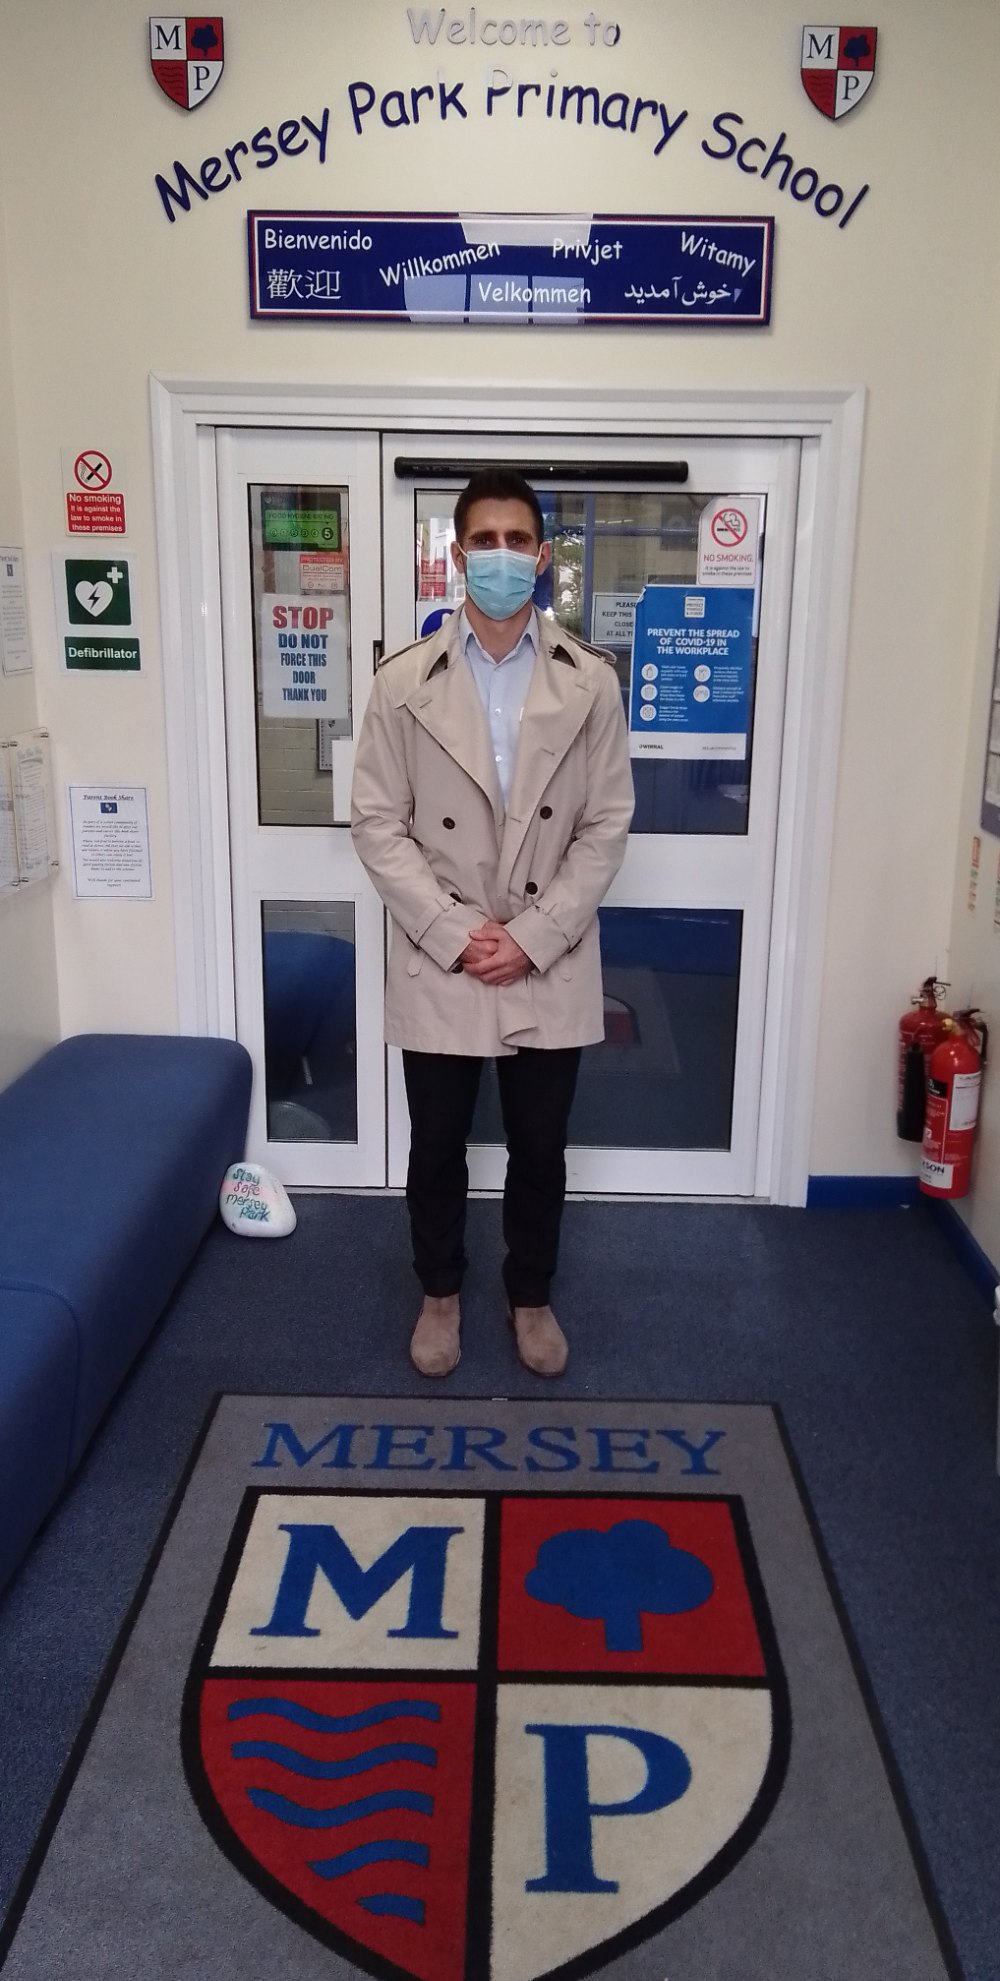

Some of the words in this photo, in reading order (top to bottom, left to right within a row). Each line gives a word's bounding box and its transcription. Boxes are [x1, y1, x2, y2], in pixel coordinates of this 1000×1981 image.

[155, 25, 183, 50] M
[406, 7, 571, 47] Welcome
[584, 12, 621, 48] to
[806, 33, 835, 59] M
[193, 66, 210, 91] P
[842, 75, 859, 100] P
[155, 107, 330, 223] Mersey
[348, 66, 467, 135] Park
[486, 67, 688, 156] Primary
[701, 111, 869, 229] School
[264, 228, 373, 250] Bienvenido
[379, 242, 501, 287] Willkommen
[552, 238, 623, 266] Privjet
[681, 231, 756, 278] Witamy
[266, 269, 342, 300] 歡迎
[478, 281, 591, 304] Velkommen
[69, 493, 82, 503] No
[83, 494, 122, 506] smoking
[703, 554, 715, 562] NO
[272, 605, 334, 630] STOP
[278, 633, 298, 649] DO
[301, 633, 329, 650] NOT
[647, 628, 687, 637] PREVENT
[688, 629, 706, 637] THE
[706, 629, 740, 638] SPREAD
[659, 637, 672, 646] OF
[675, 638, 716, 647] COVID-19
[717, 638, 727, 647] IN
[68, 646, 137, 660] Defibrillator
[280, 652, 307, 667] FORCE
[307, 653, 327, 667] THIS
[656, 646, 674, 655] THE
[675, 647, 730, 655] WORKPLACE
[292, 670, 316, 685] DOOR
[282, 687, 310, 701] THANK
[310, 688, 327, 702] YOU
[251, 1423, 727, 1475] MERSEY
[249, 1523, 465, 1639] M
[525, 1724, 692, 1893] P
